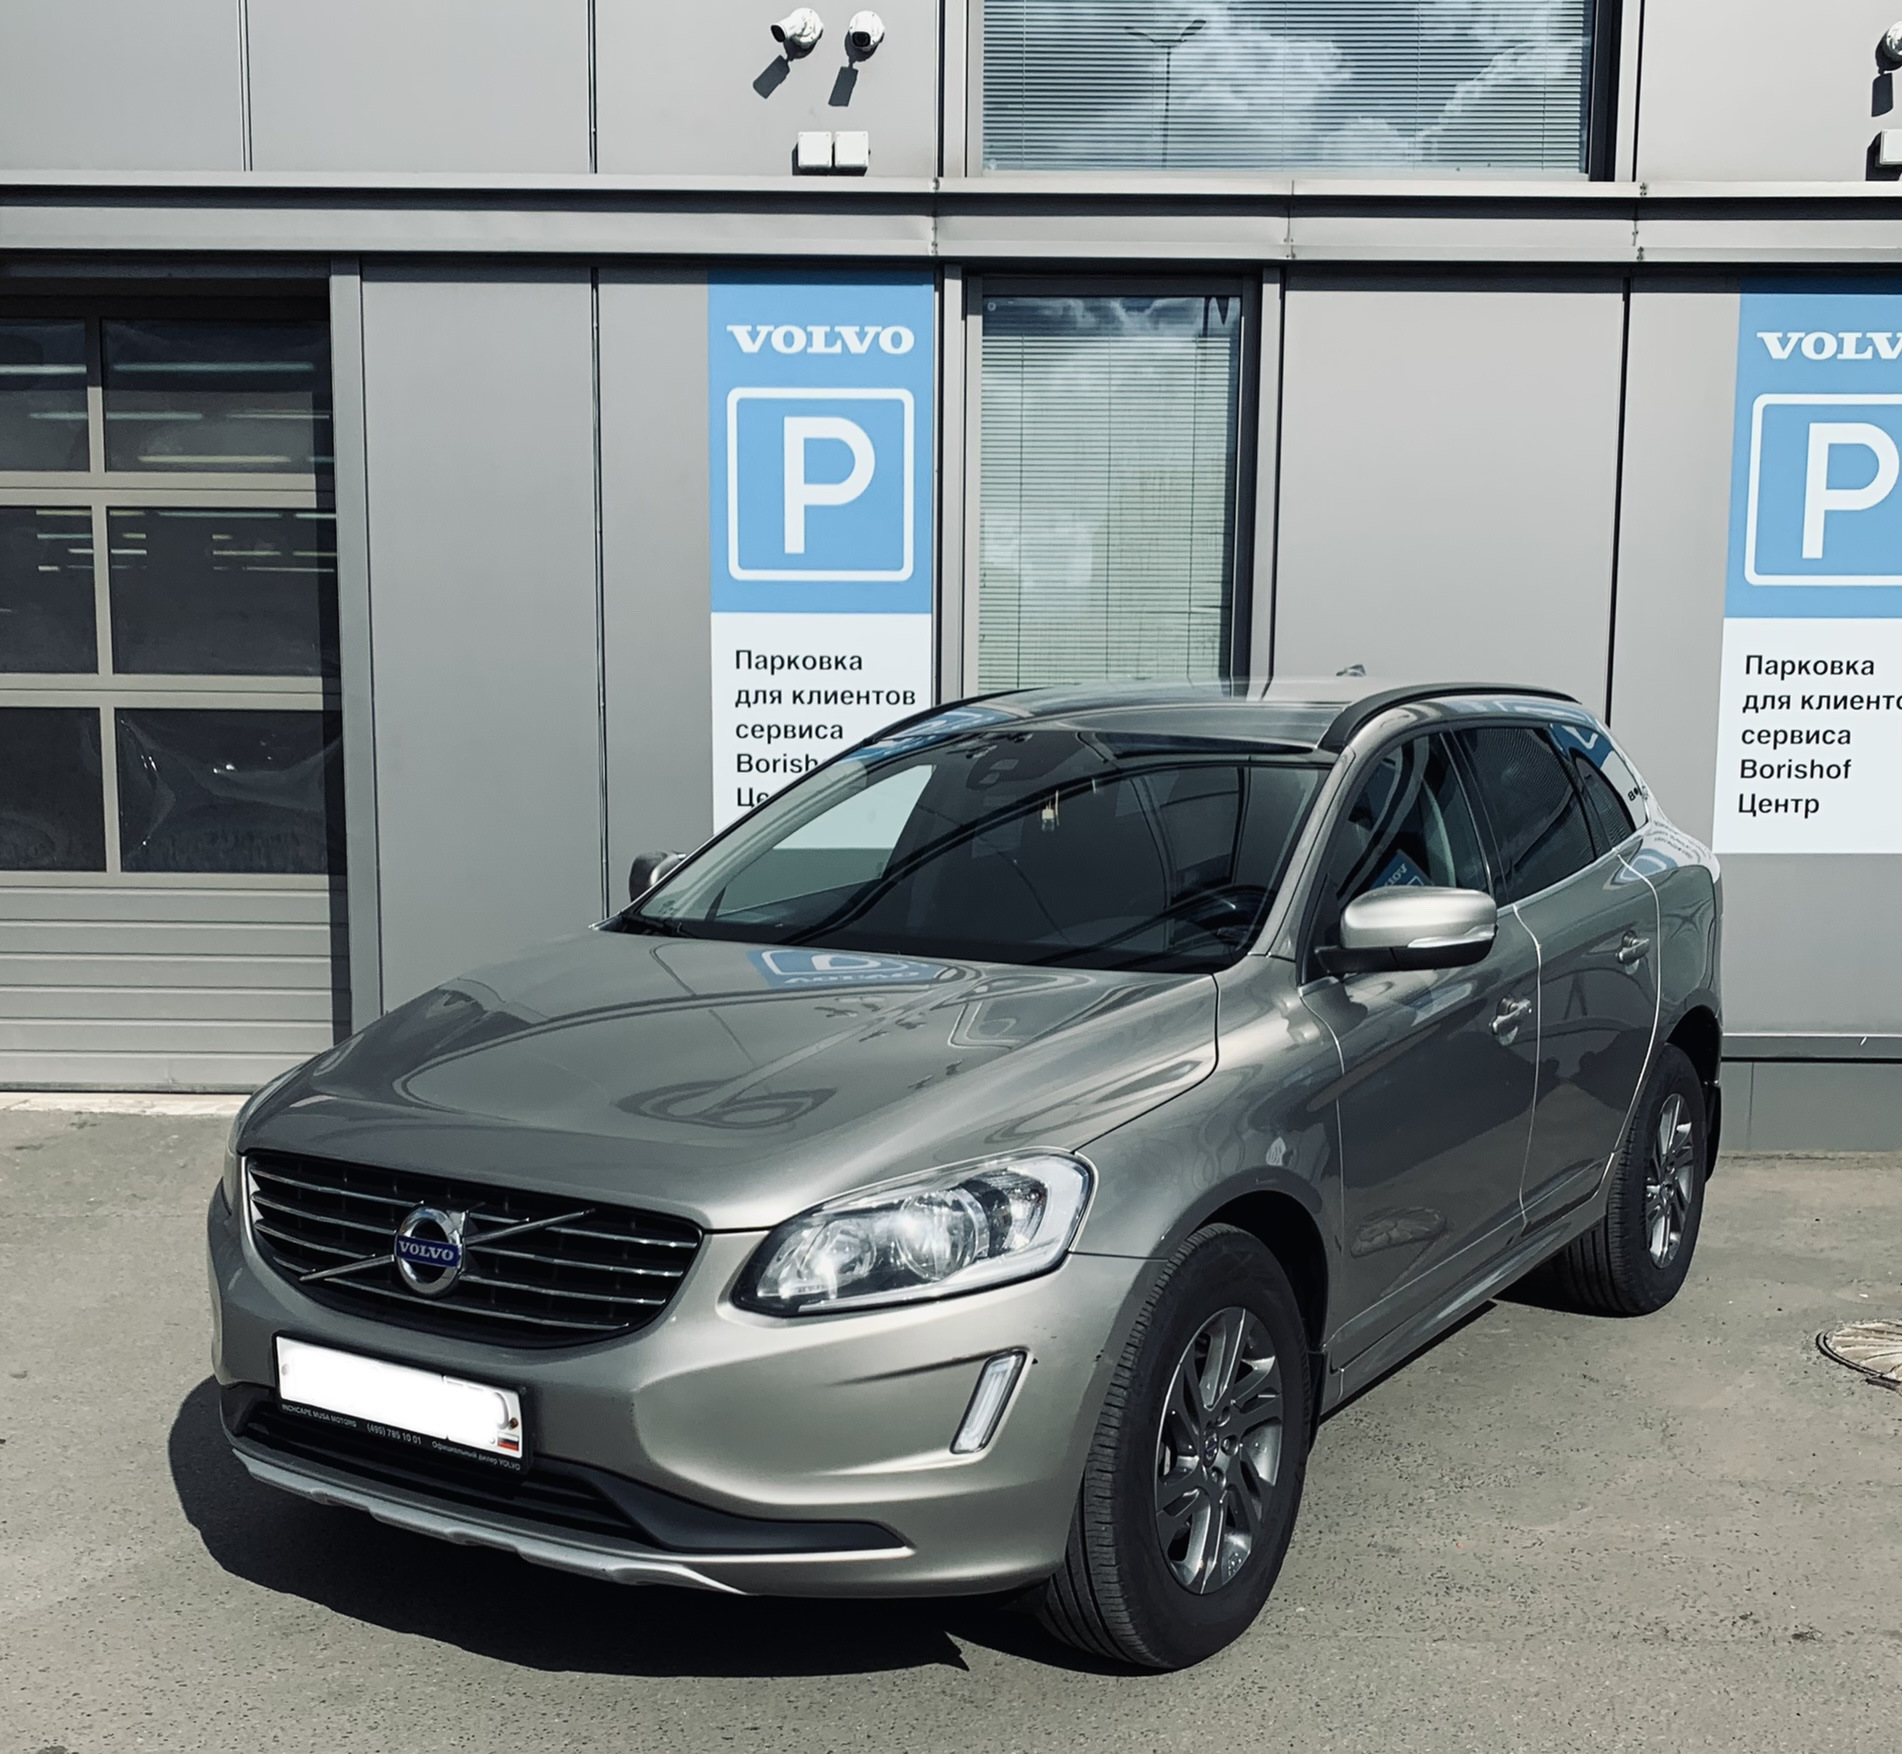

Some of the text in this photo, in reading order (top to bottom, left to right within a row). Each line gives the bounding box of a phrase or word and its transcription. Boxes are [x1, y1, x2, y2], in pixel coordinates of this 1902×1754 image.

[726, 325, 915, 354] VOLVO
[783, 416, 875, 554] P
[1801, 422, 1900, 559] P
[735, 649, 863, 676] Парковка
[1744, 654, 1876, 681] Парковка
[735, 689, 917, 708] для клиентов
[1742, 694, 1792, 714] для
[735, 723, 844, 745] сервиса
[1741, 728, 1852, 750] сервиса
[736, 753, 819, 774] Borish
[1739, 758, 1853, 780] Borishof
[1737, 792, 1821, 820] Центр
[398, 1240, 454, 1261] VOLVO
[499, 1458, 521, 1471] VOLVO
